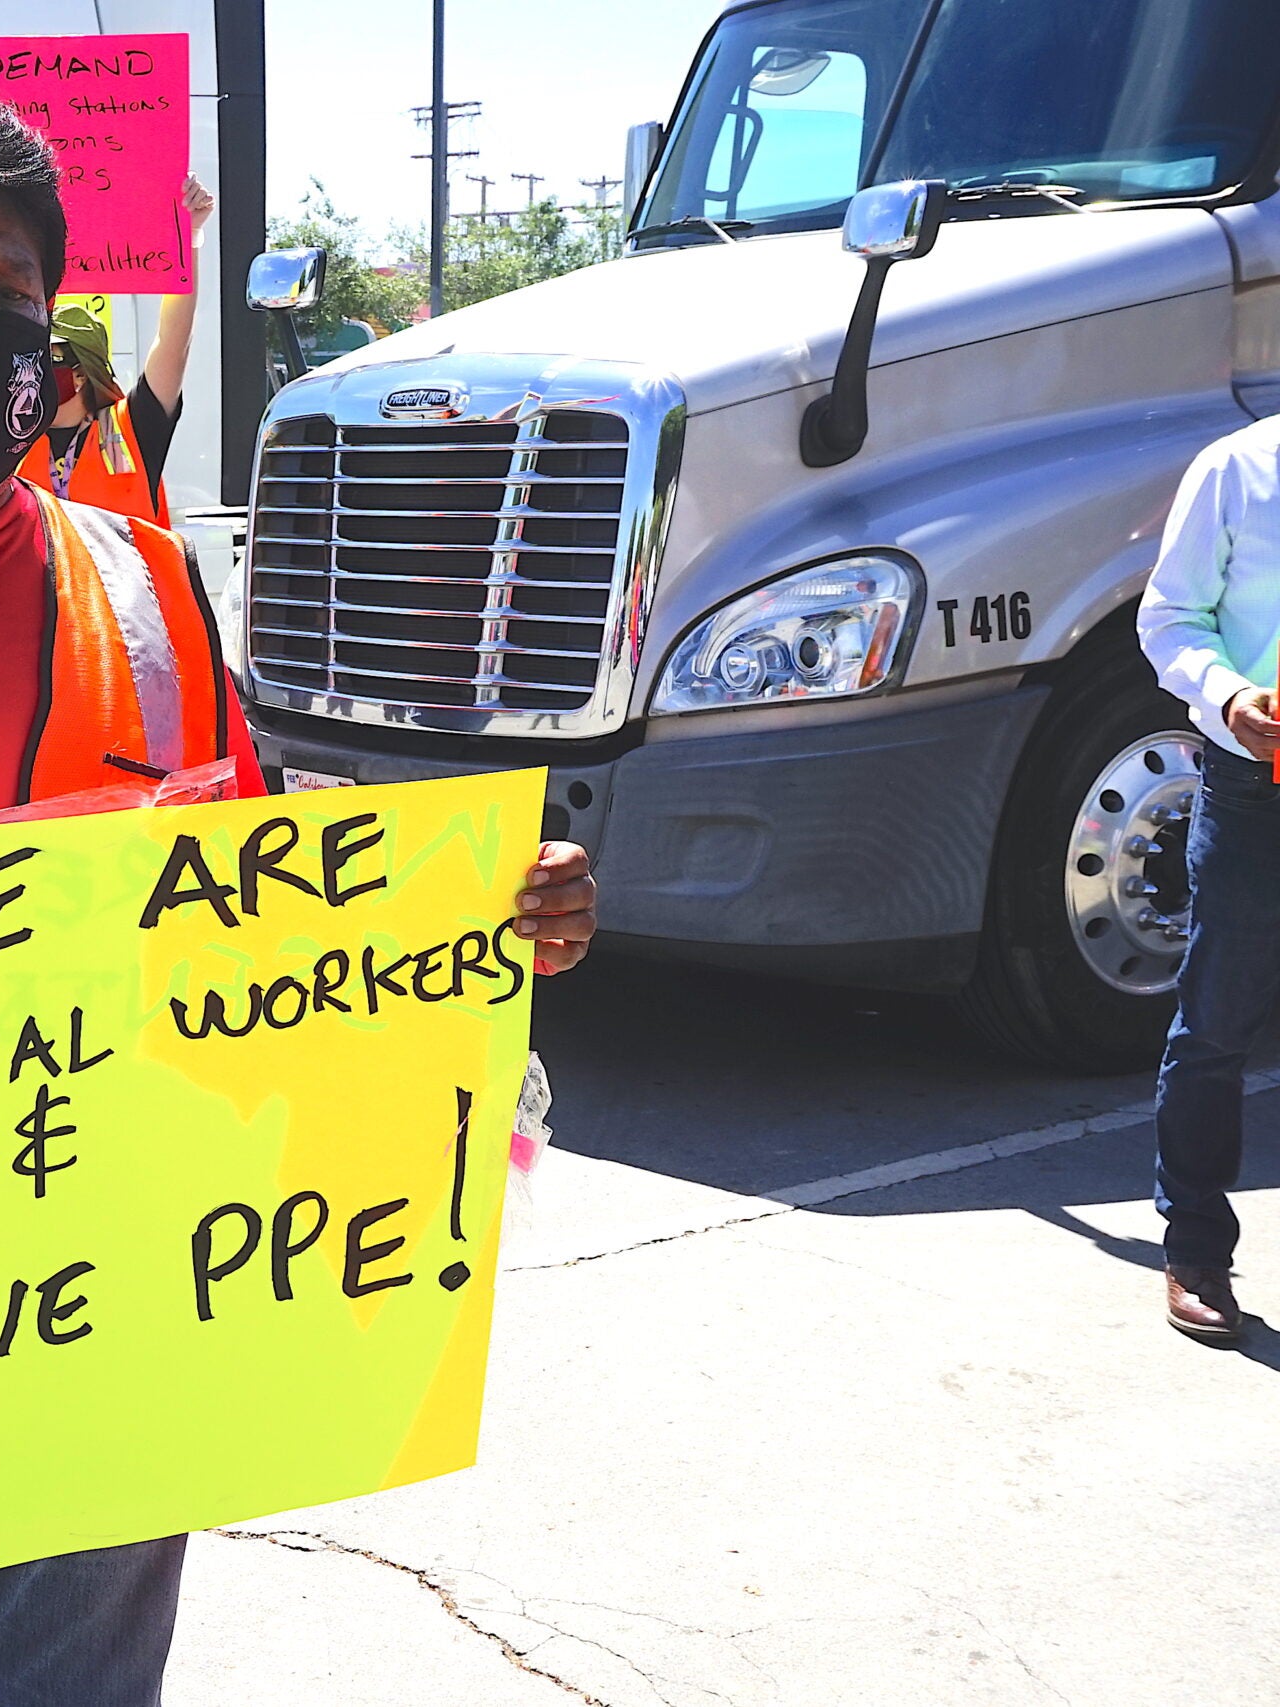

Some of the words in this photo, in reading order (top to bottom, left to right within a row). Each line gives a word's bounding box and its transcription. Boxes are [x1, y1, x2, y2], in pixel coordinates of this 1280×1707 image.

[388, 389, 449, 406] FREIGHTLINER
[937, 599, 958, 647] T
[970, 591, 1031, 643] 416
[139, 813, 388, 930] ARE
[169, 917, 525, 1040] WORKERS
[192, 1088, 473, 1322] PPE!
